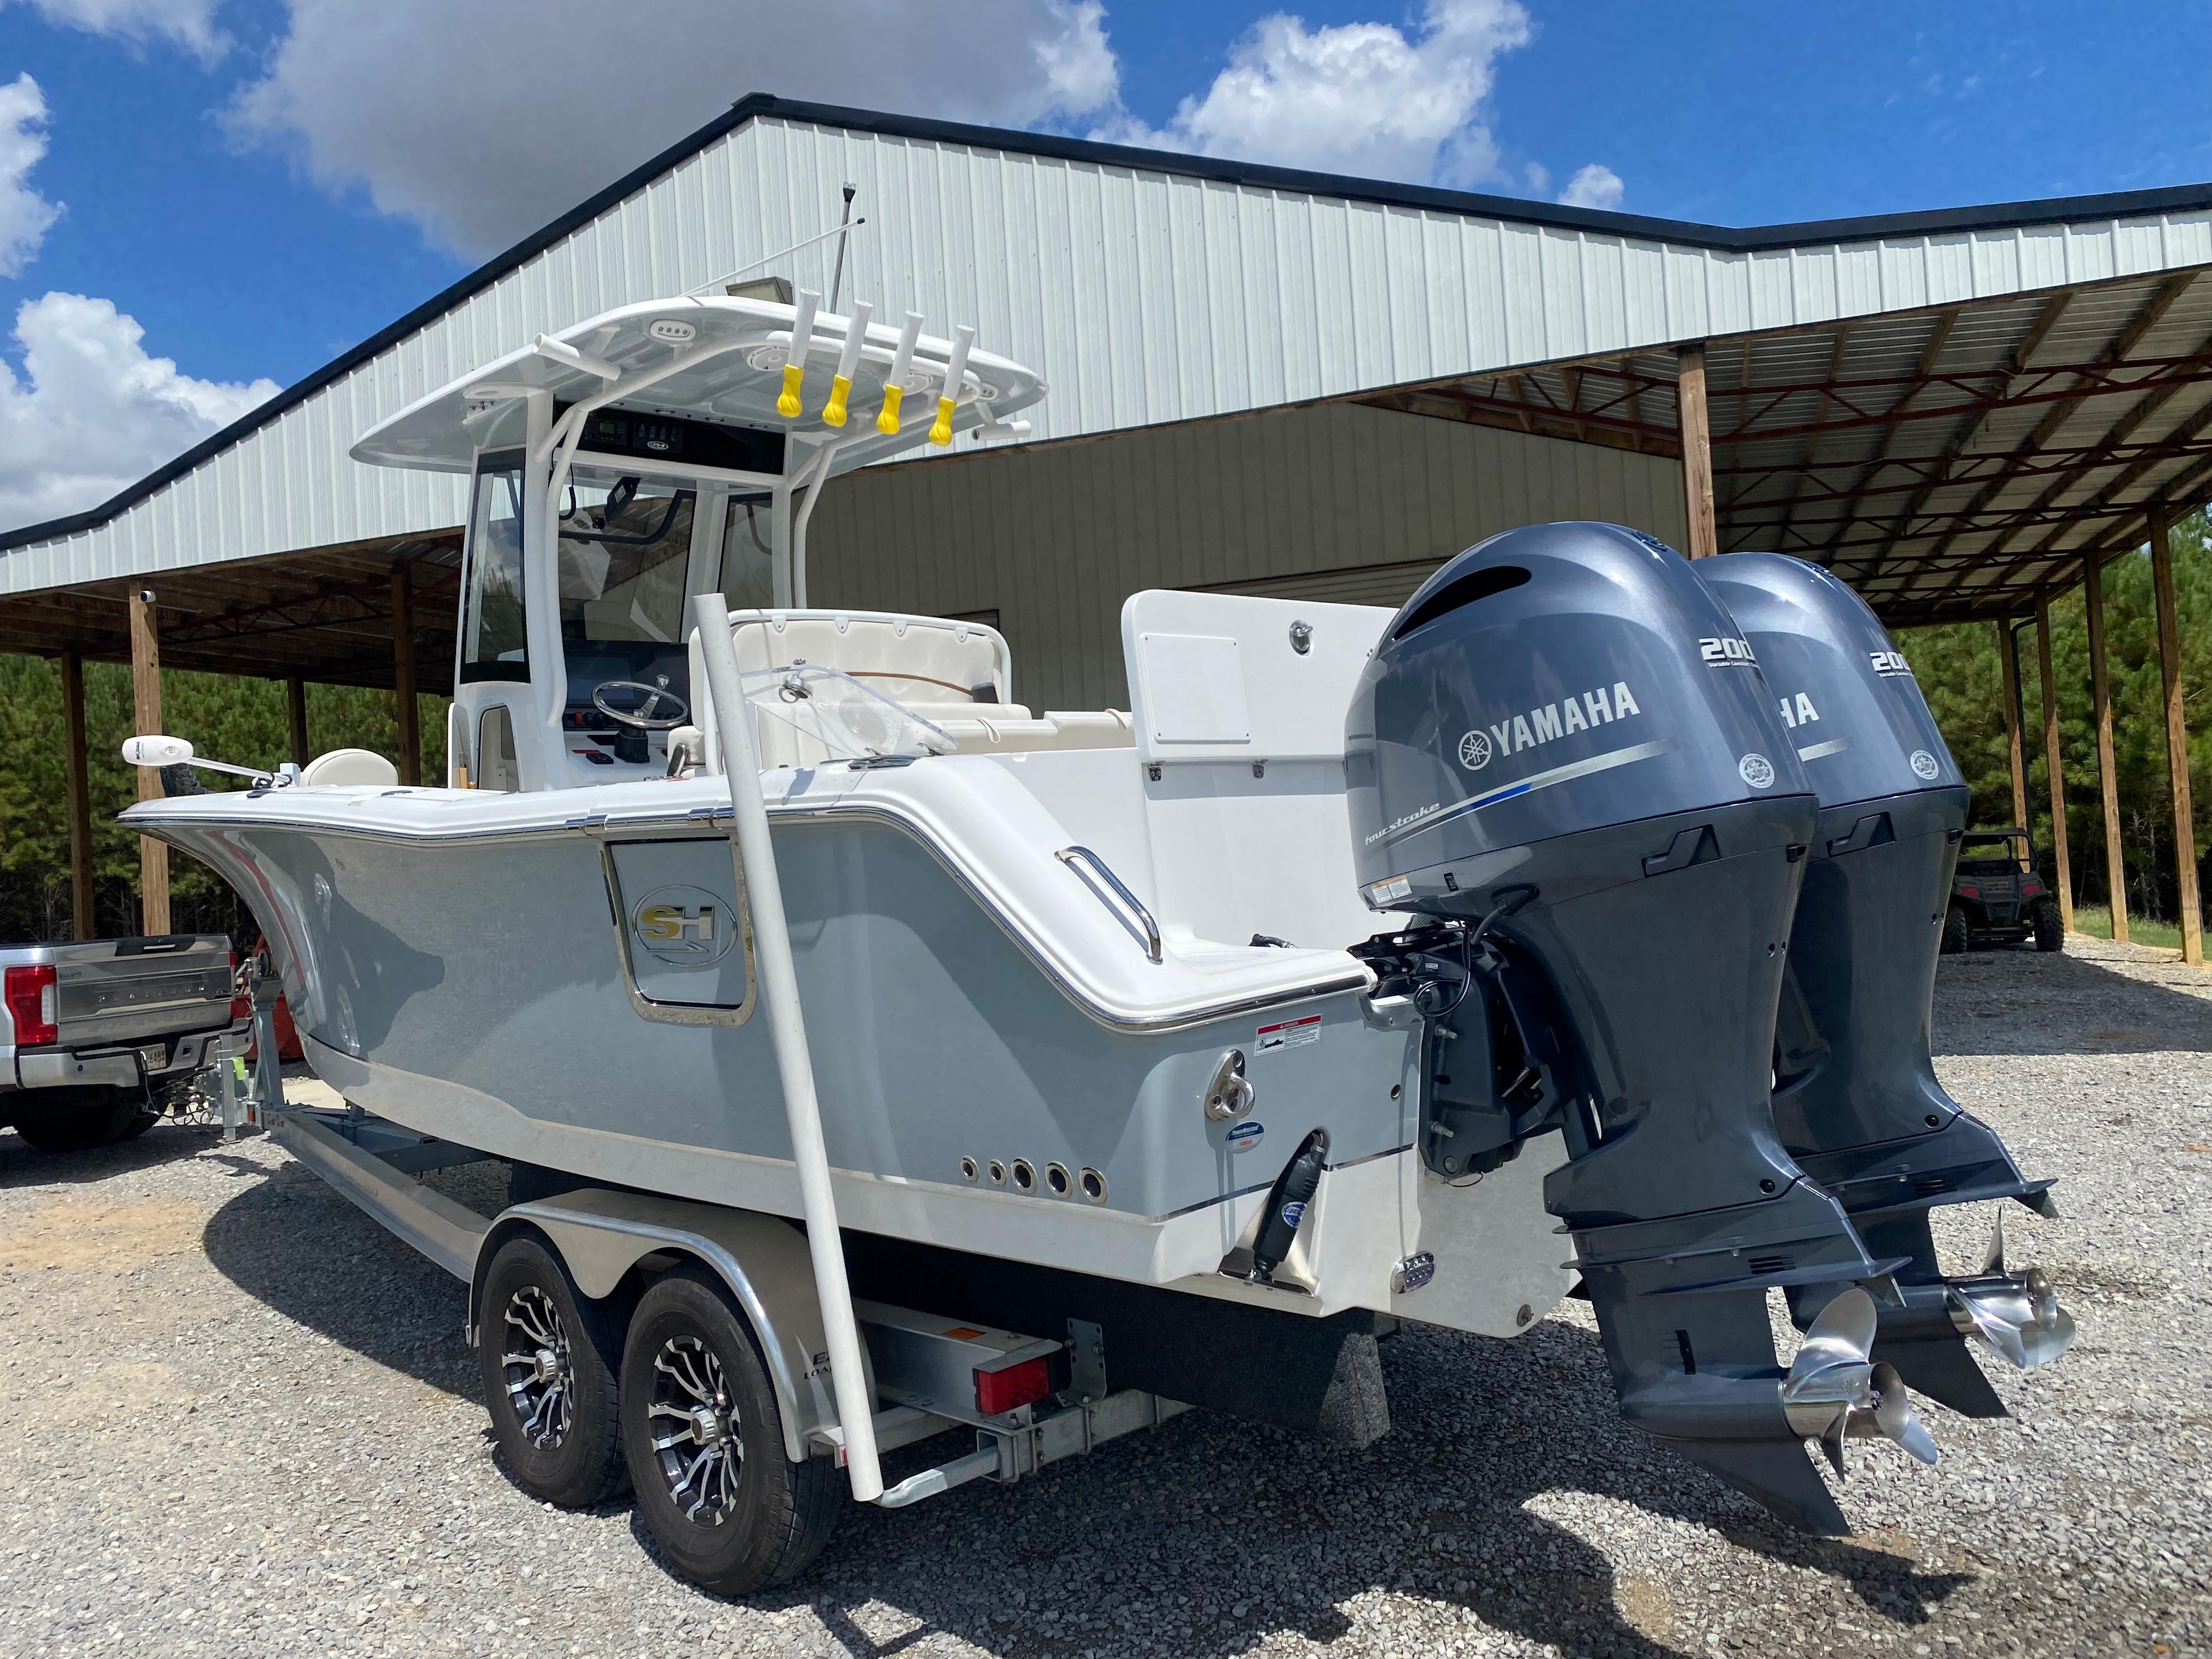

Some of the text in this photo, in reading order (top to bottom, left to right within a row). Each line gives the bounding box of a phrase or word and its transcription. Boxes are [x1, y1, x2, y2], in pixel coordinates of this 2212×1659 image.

[1699, 637, 1756, 661] 200
[1489, 681, 1640, 757] YAMAHA
[641, 906, 714, 940] SH
[804, 1367, 831, 1379] LOA
